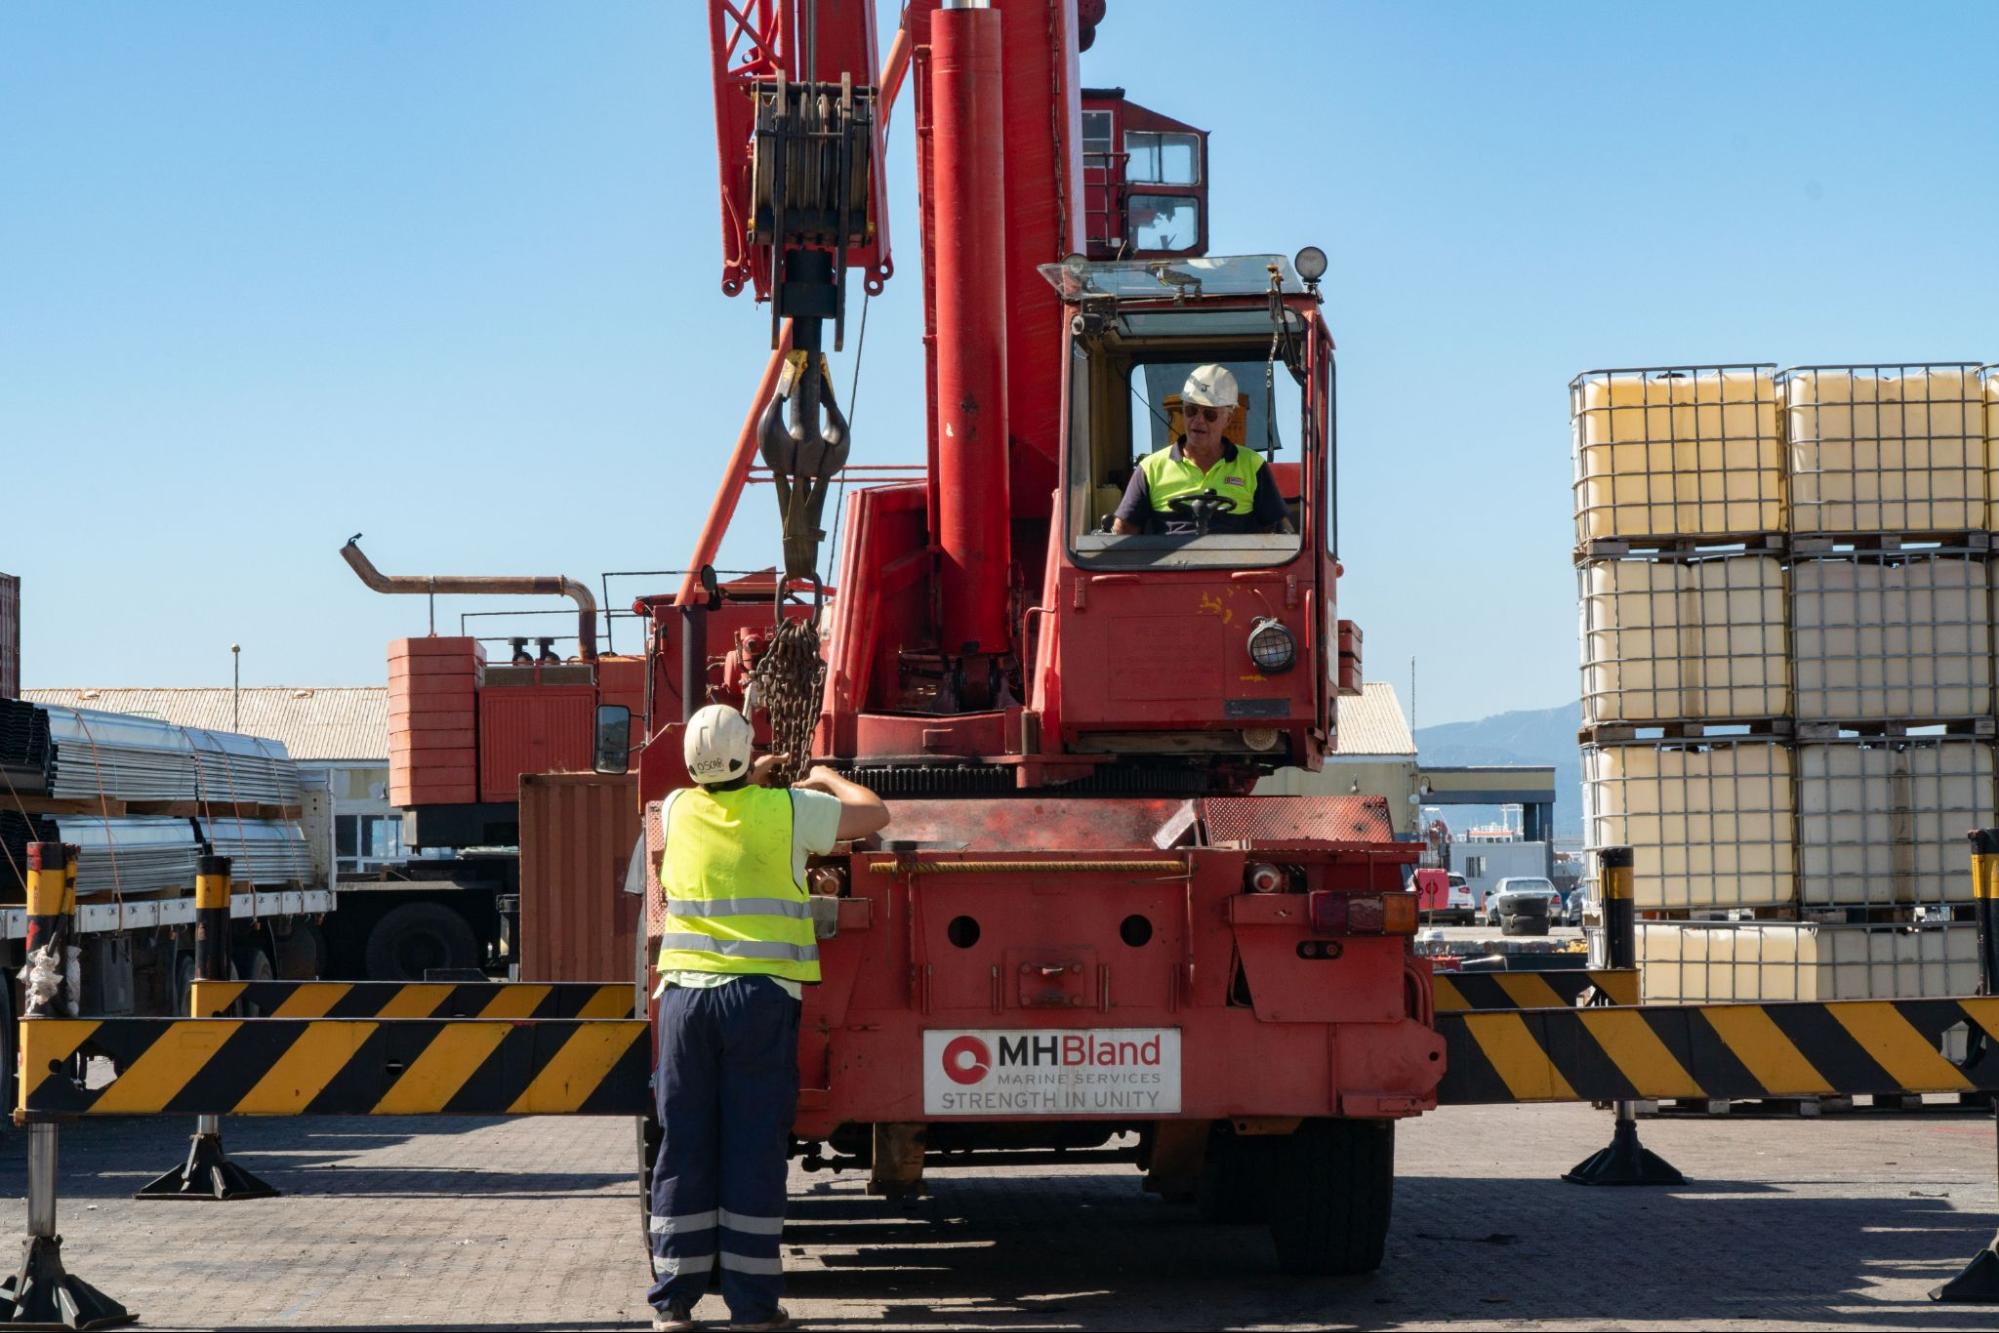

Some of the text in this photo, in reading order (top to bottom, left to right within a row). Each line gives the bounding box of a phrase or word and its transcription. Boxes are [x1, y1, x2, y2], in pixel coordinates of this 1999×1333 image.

[998, 1034, 1161, 1067] MHBland
[998, 1072, 1161, 1085] MARINE SERVICES
[941, 1090, 1160, 1109] STRENGTH IN UNITY
